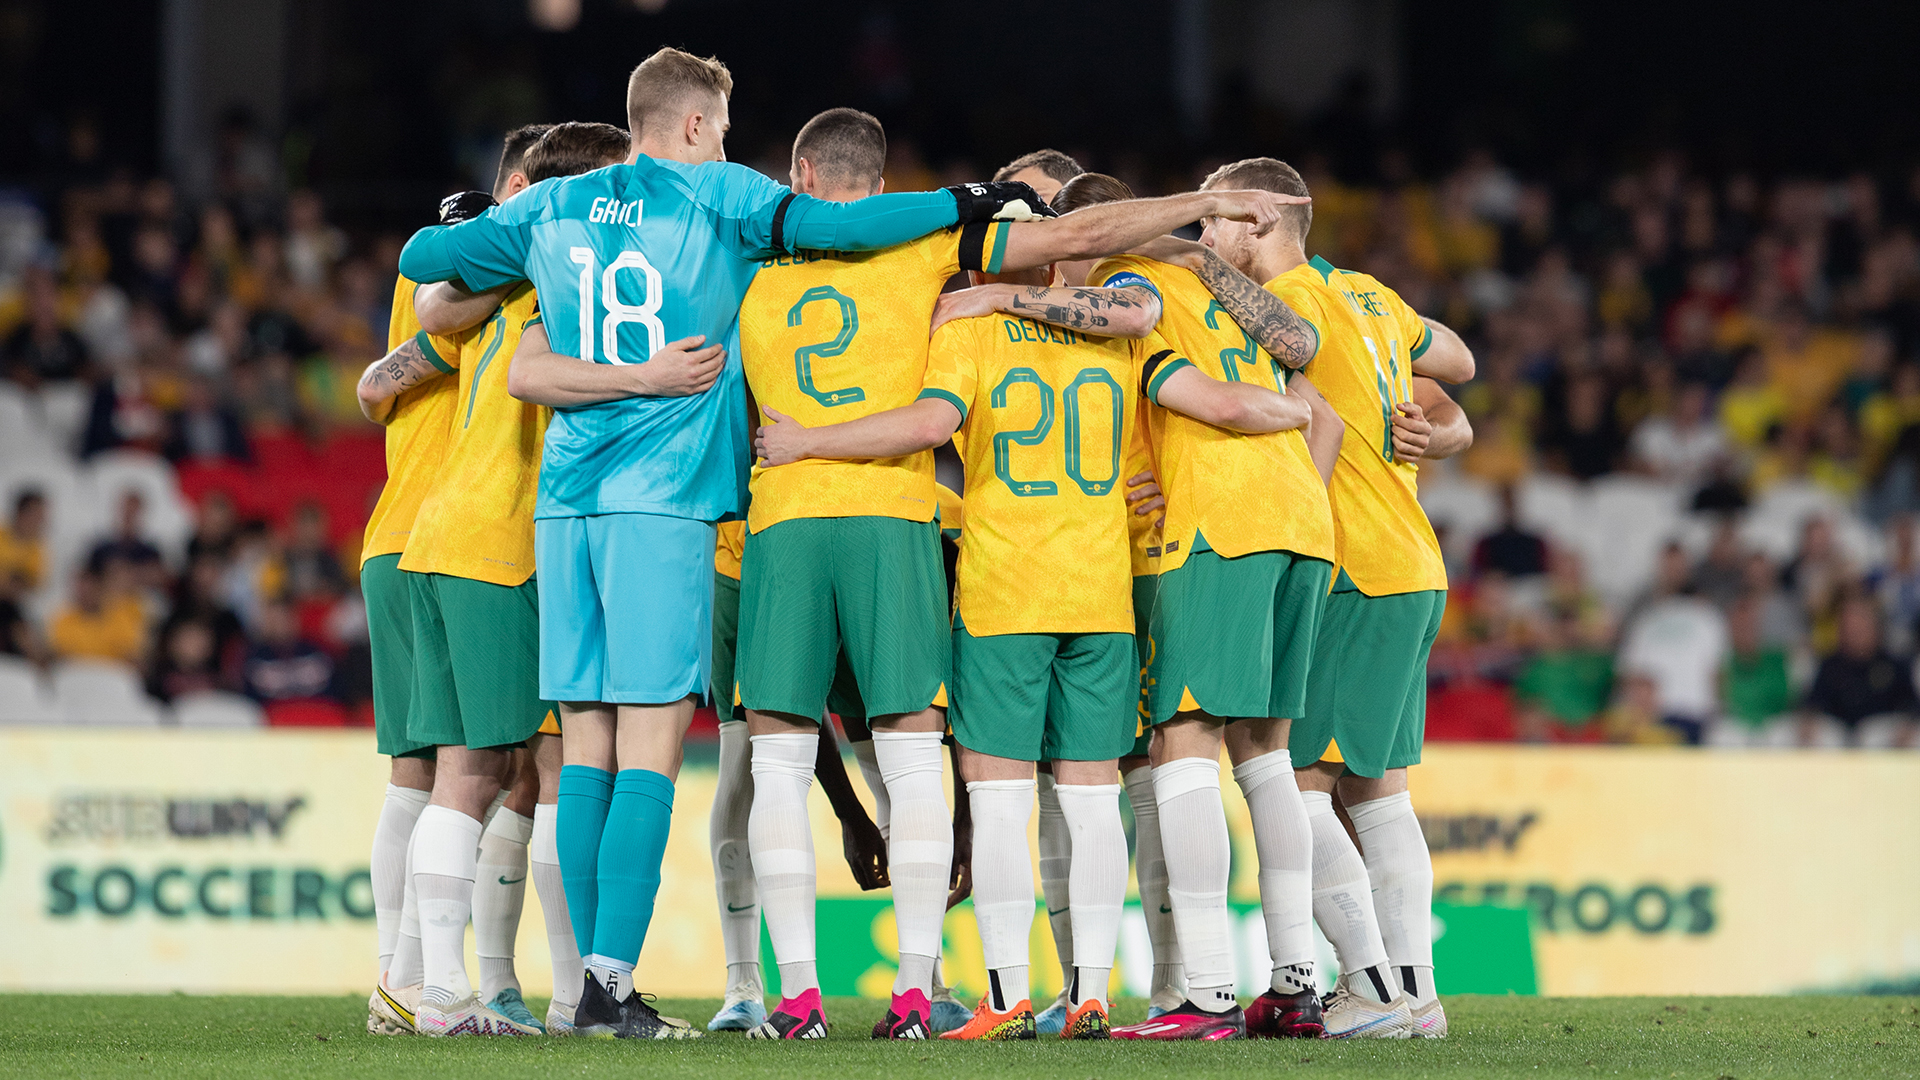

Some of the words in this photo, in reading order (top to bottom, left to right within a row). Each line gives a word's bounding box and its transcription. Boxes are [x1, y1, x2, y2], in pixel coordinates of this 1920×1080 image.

[569, 246, 666, 366] 18
[787, 285, 866, 408] 2
[990, 366, 1124, 497] 20
[48, 866, 377, 919] SOCCERO
